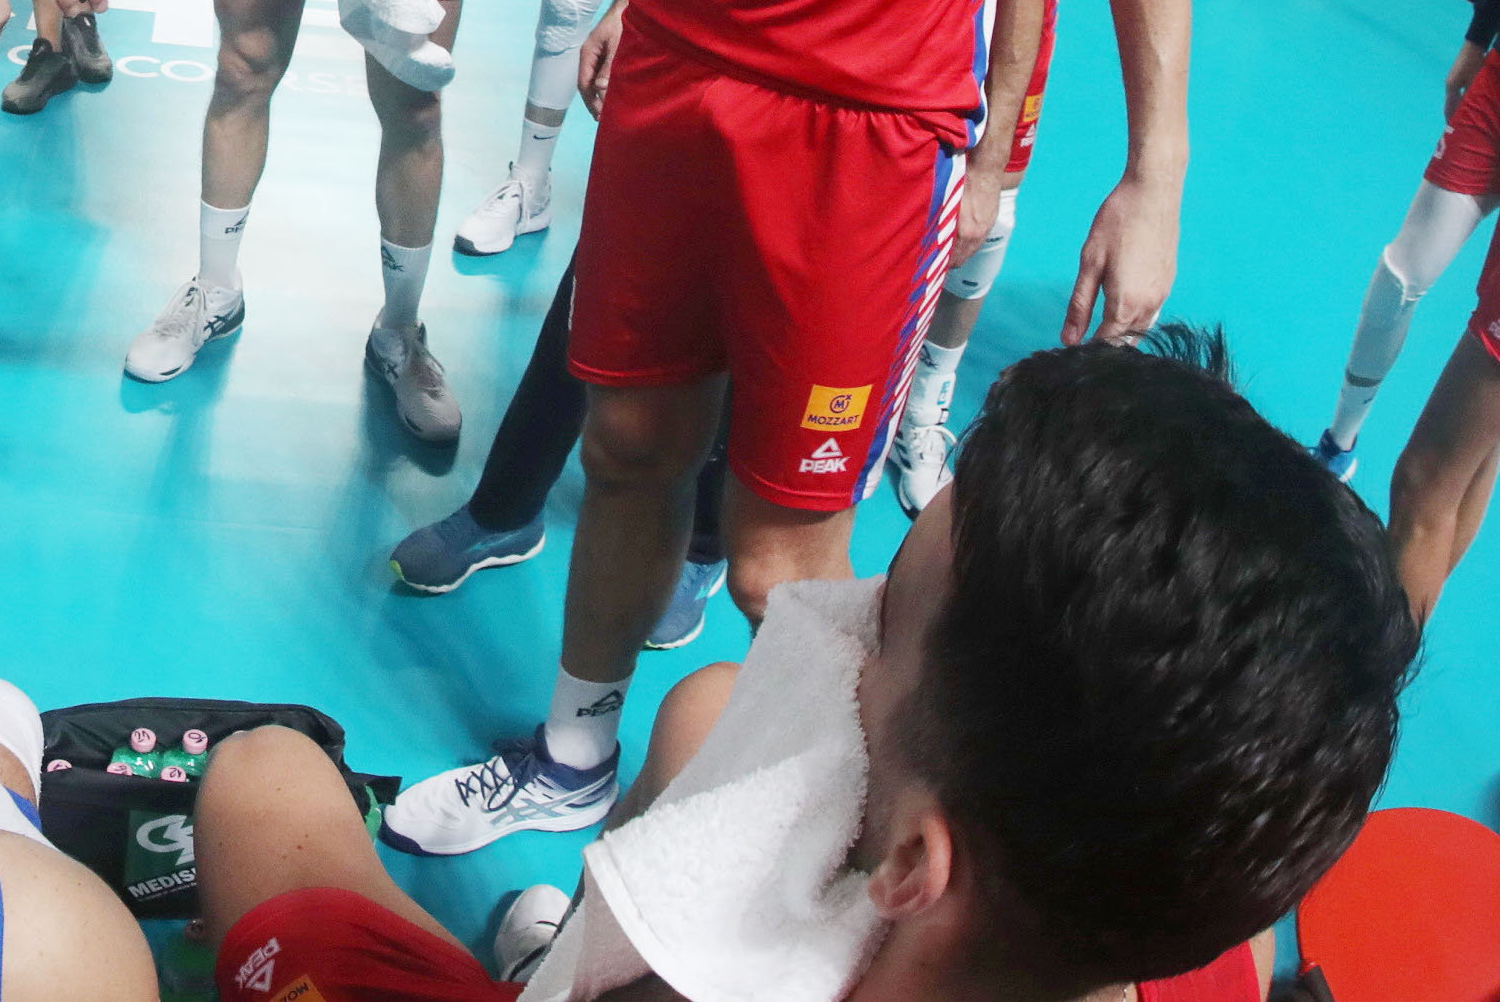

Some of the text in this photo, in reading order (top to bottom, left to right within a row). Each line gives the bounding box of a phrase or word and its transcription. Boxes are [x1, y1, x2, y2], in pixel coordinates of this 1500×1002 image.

[806, 413, 861, 427] MOZZART
[798, 456, 851, 474] PEAK
[234, 936, 283, 991] PEAK
